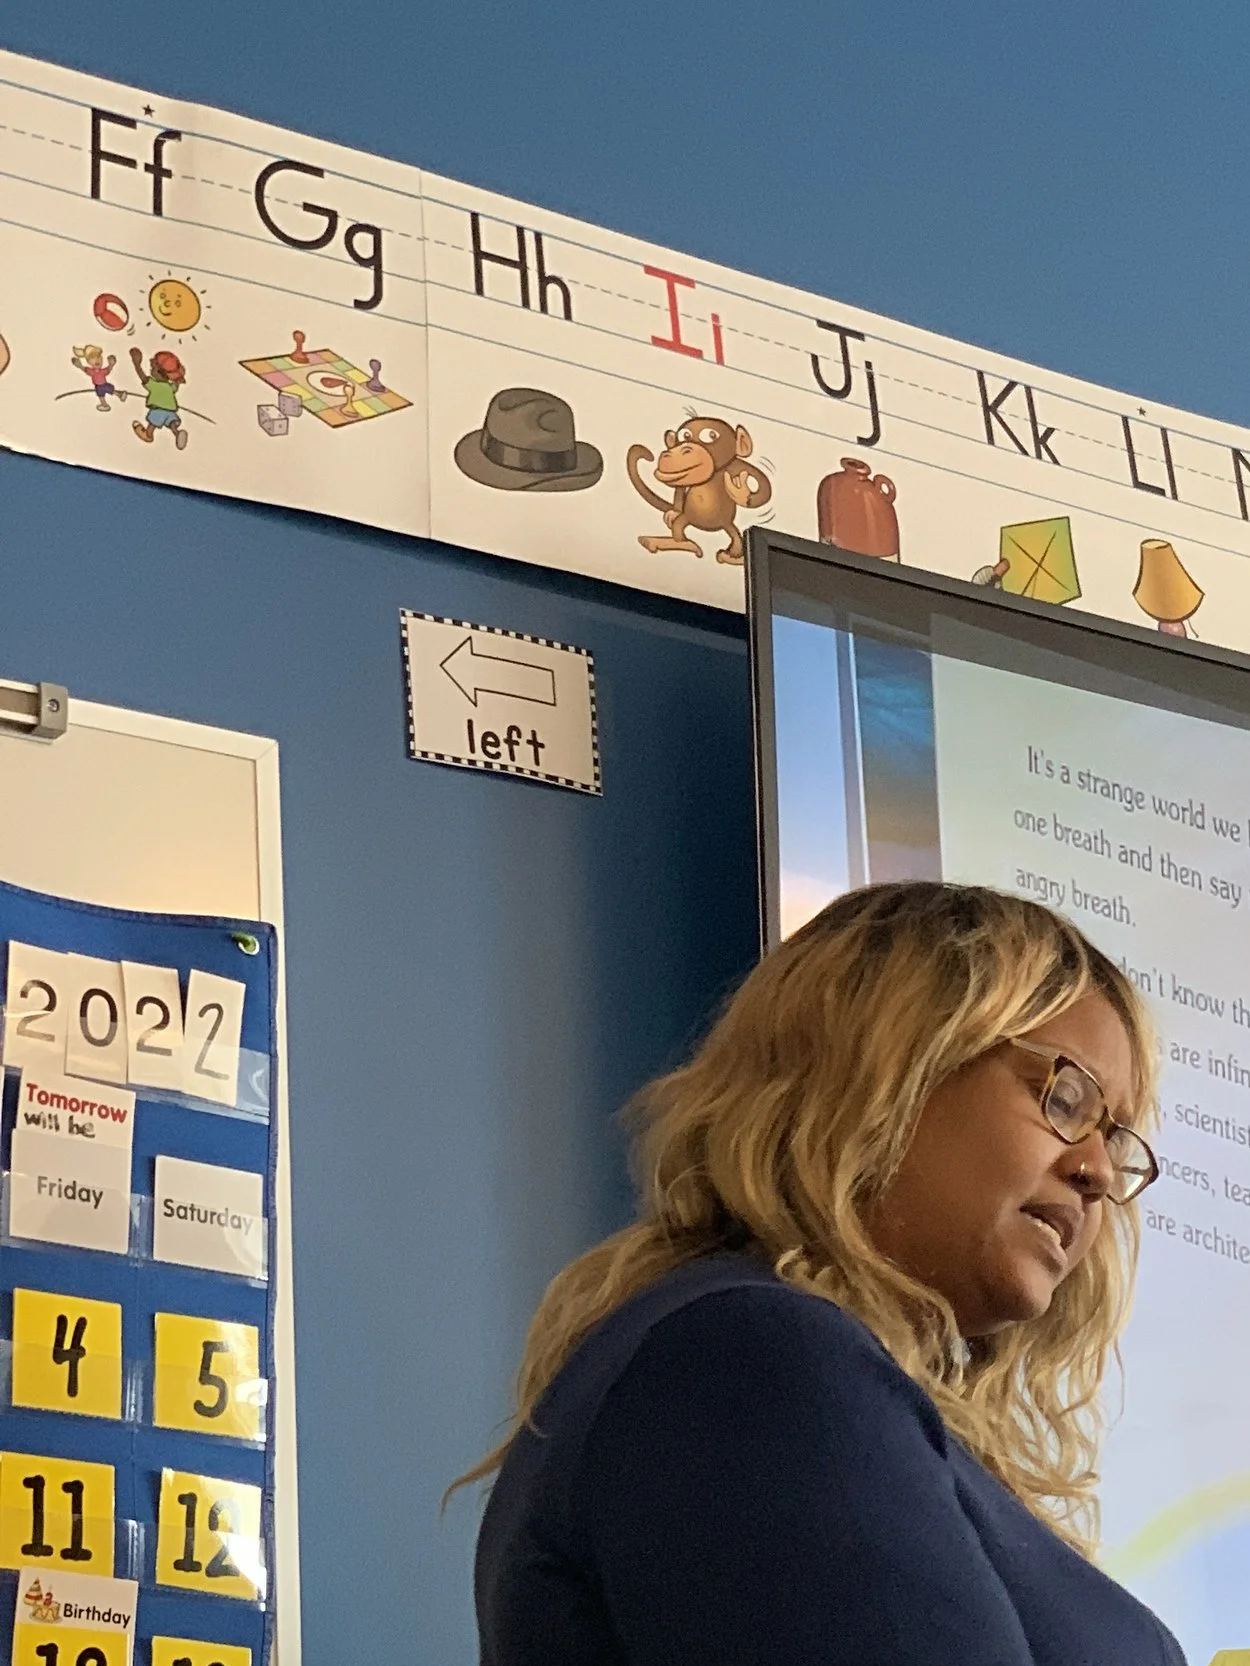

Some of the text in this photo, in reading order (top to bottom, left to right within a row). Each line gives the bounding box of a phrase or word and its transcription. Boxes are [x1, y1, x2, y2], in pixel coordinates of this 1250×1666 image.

[89, 107, 182, 217] Ff
[254, 160, 385, 310] Gg
[469, 212, 574, 321] Hh
[644, 264, 725, 366] Ii
[810, 320, 880, 446] Jj
[975, 369, 1061, 467] Kk
[1120, 416, 1178, 501] Ll
[467, 718, 545, 767] left
[1027, 745, 1055, 779] It's
[1060, 762, 1071, 785] a
[1077, 766, 1146, 813] strange
[1152, 794, 1205, 831] world
[1213, 815, 1241, 844] we
[1013, 807, 1047, 837] one
[1053, 815, 1111, 860] breath
[1118, 843, 1153, 873] and
[1160, 853, 1202, 891] then
[1210, 873, 1242, 908] say
[1016, 865, 1136, 929] angry breath.
[1171, 973, 1225, 1020] know
[1170, 1039, 1202, 1070] are
[23, 1110, 97, 1139] will be
[26, 1082, 129, 1125] Tomorrow
[37, 1174, 104, 1209] Friday
[1158, 1153, 1216, 1198] ncers,
[162, 1198, 255, 1236] Saturday
[1146, 1207, 1177, 1238] are
[51, 1313, 88, 1398] 4
[192, 1340, 230, 1418] 5
[20, 1474, 93, 1562] 11
[172, 1490, 241, 1578] 12
[63, 1602, 132, 1630] Birthday
